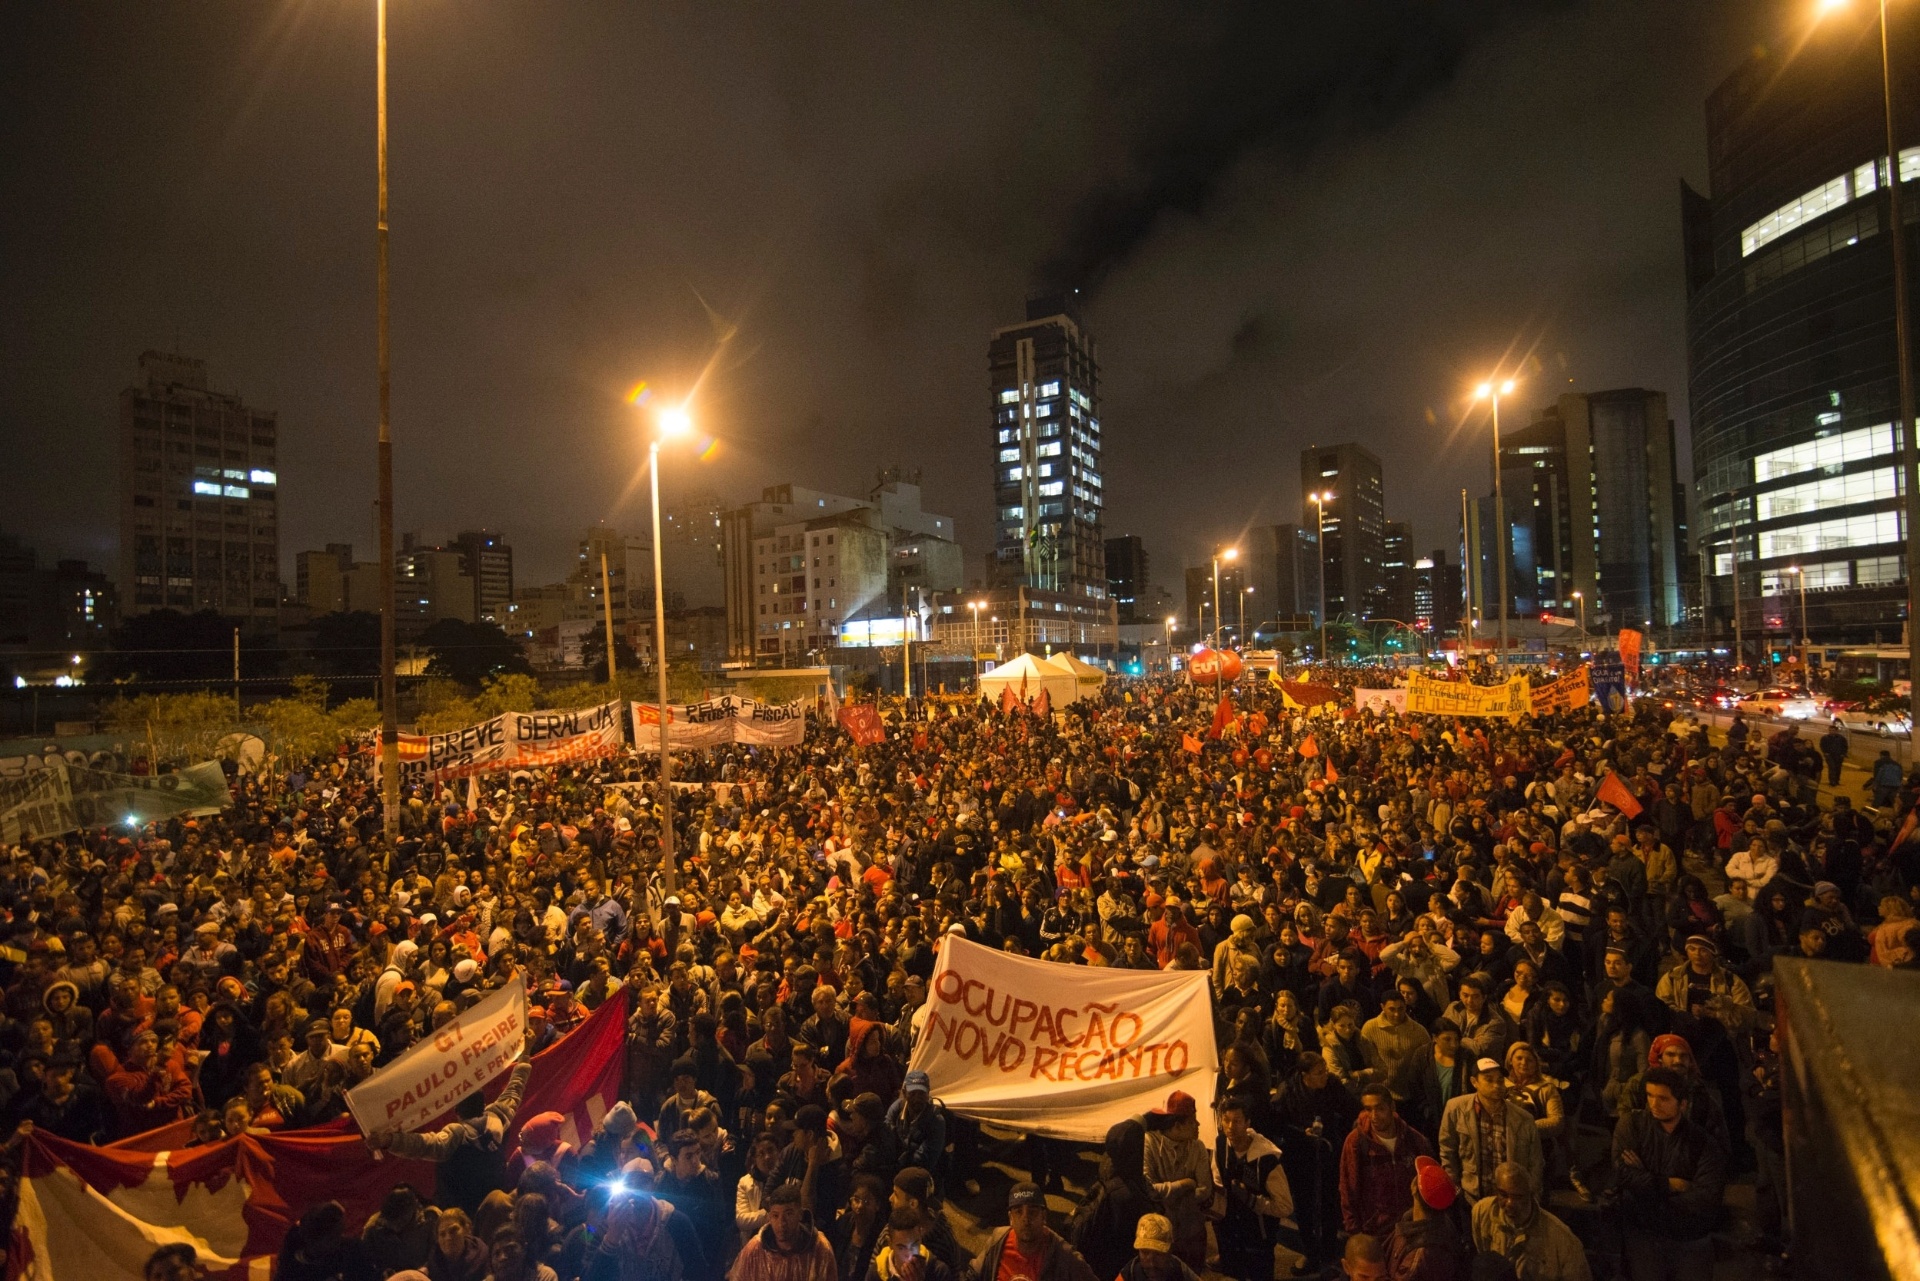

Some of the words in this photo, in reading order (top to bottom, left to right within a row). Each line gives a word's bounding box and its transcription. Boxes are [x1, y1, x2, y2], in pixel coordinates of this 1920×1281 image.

[429, 718, 504, 759] GREVE
[517, 713, 586, 741] GERAL
[434, 1021, 465, 1053] G7
[925, 1011, 1026, 1073] NOVO
[1030, 1039, 1188, 1082] RECANTO
[385, 1060, 459, 1120] PAULO
[461, 1013, 519, 1067] FREIRE
[435, 1078, 473, 1110] LUTA
